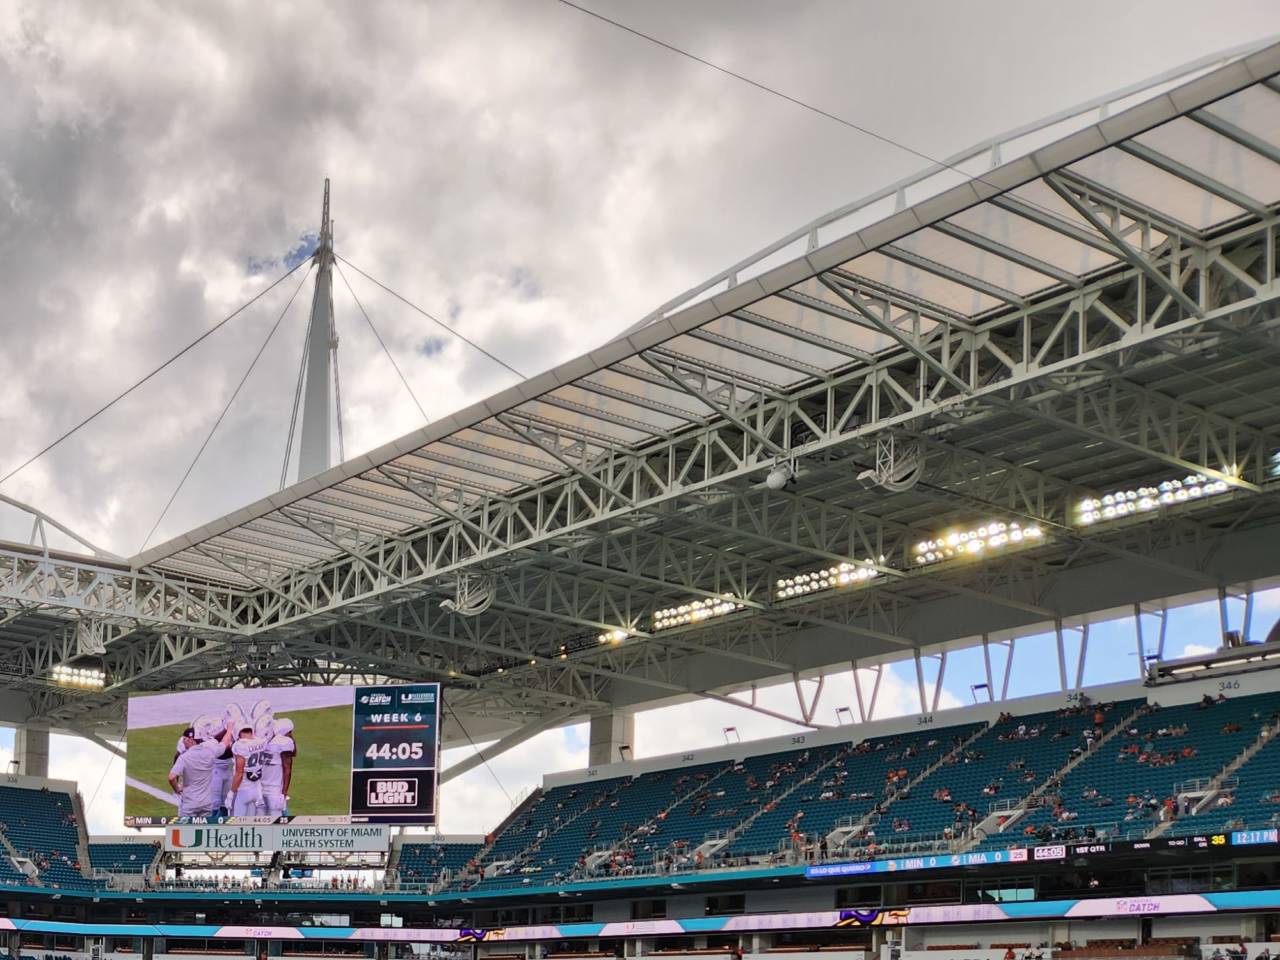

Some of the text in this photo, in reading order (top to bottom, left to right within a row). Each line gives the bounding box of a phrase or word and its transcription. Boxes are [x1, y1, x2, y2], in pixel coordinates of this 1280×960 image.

[1219, 680, 1240, 691] 346
[371, 713, 422, 722] WEEK 6
[917, 715, 933, 725] 344
[791, 735, 805, 745] 343
[365, 743, 423, 760] 44:05
[681, 754, 695, 763] 342
[377, 782, 408, 793] BUD
[370, 792, 415, 804] LIGHT
[282, 827, 382, 837] UNIVERSITY OF MIAMI
[282, 839, 354, 848] HEALTH SYSTEM
[1211, 835, 1225, 846] 35
[1237, 832, 1262, 844] 12:17
[1035, 847, 1064, 858] 44:05
[906, 860, 923, 869] MIN
[969, 854, 987, 864] MIA
[1128, 902, 1160, 912] CATCH
